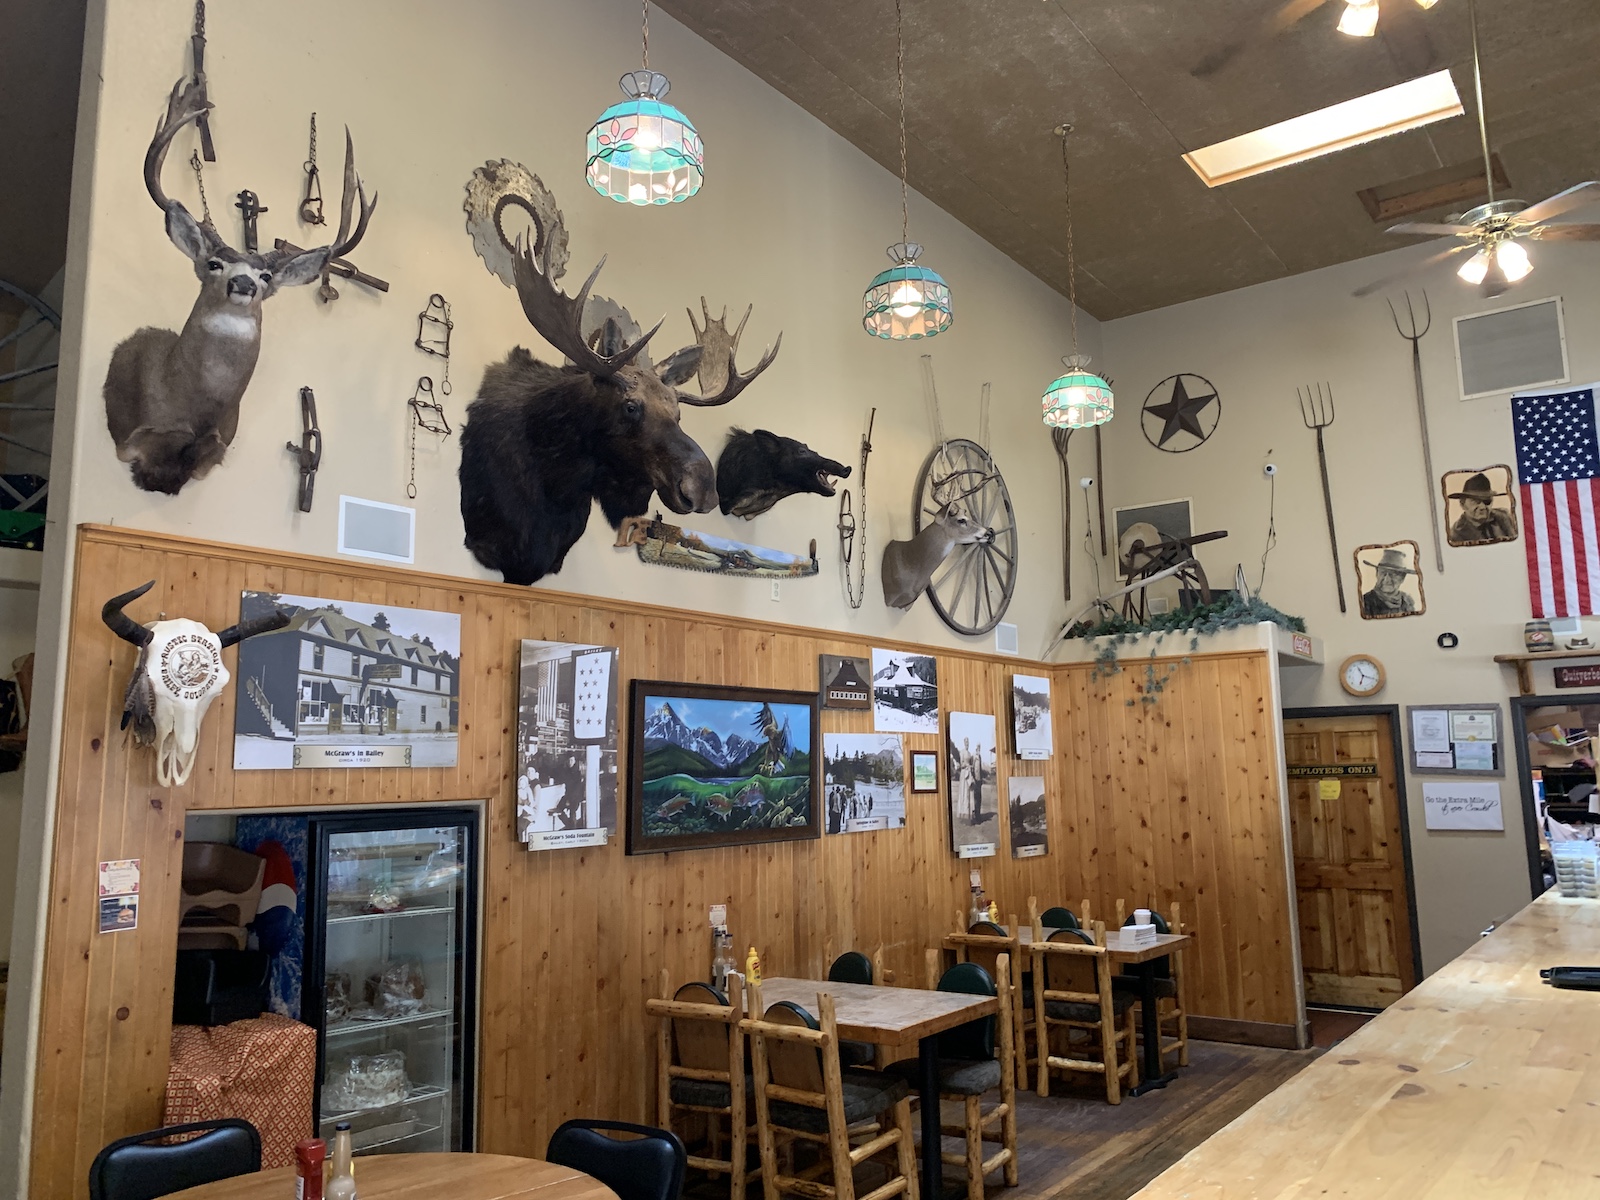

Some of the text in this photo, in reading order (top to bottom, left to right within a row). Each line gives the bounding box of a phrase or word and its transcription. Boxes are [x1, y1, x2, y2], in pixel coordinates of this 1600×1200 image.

[161, 634, 220, 665] RUSTIC STATION
[183, 674, 218, 700] COLORADO
[365, 750, 385, 759] Bailey
[1287, 766, 1374, 775] EMPLOYEES ONLY
